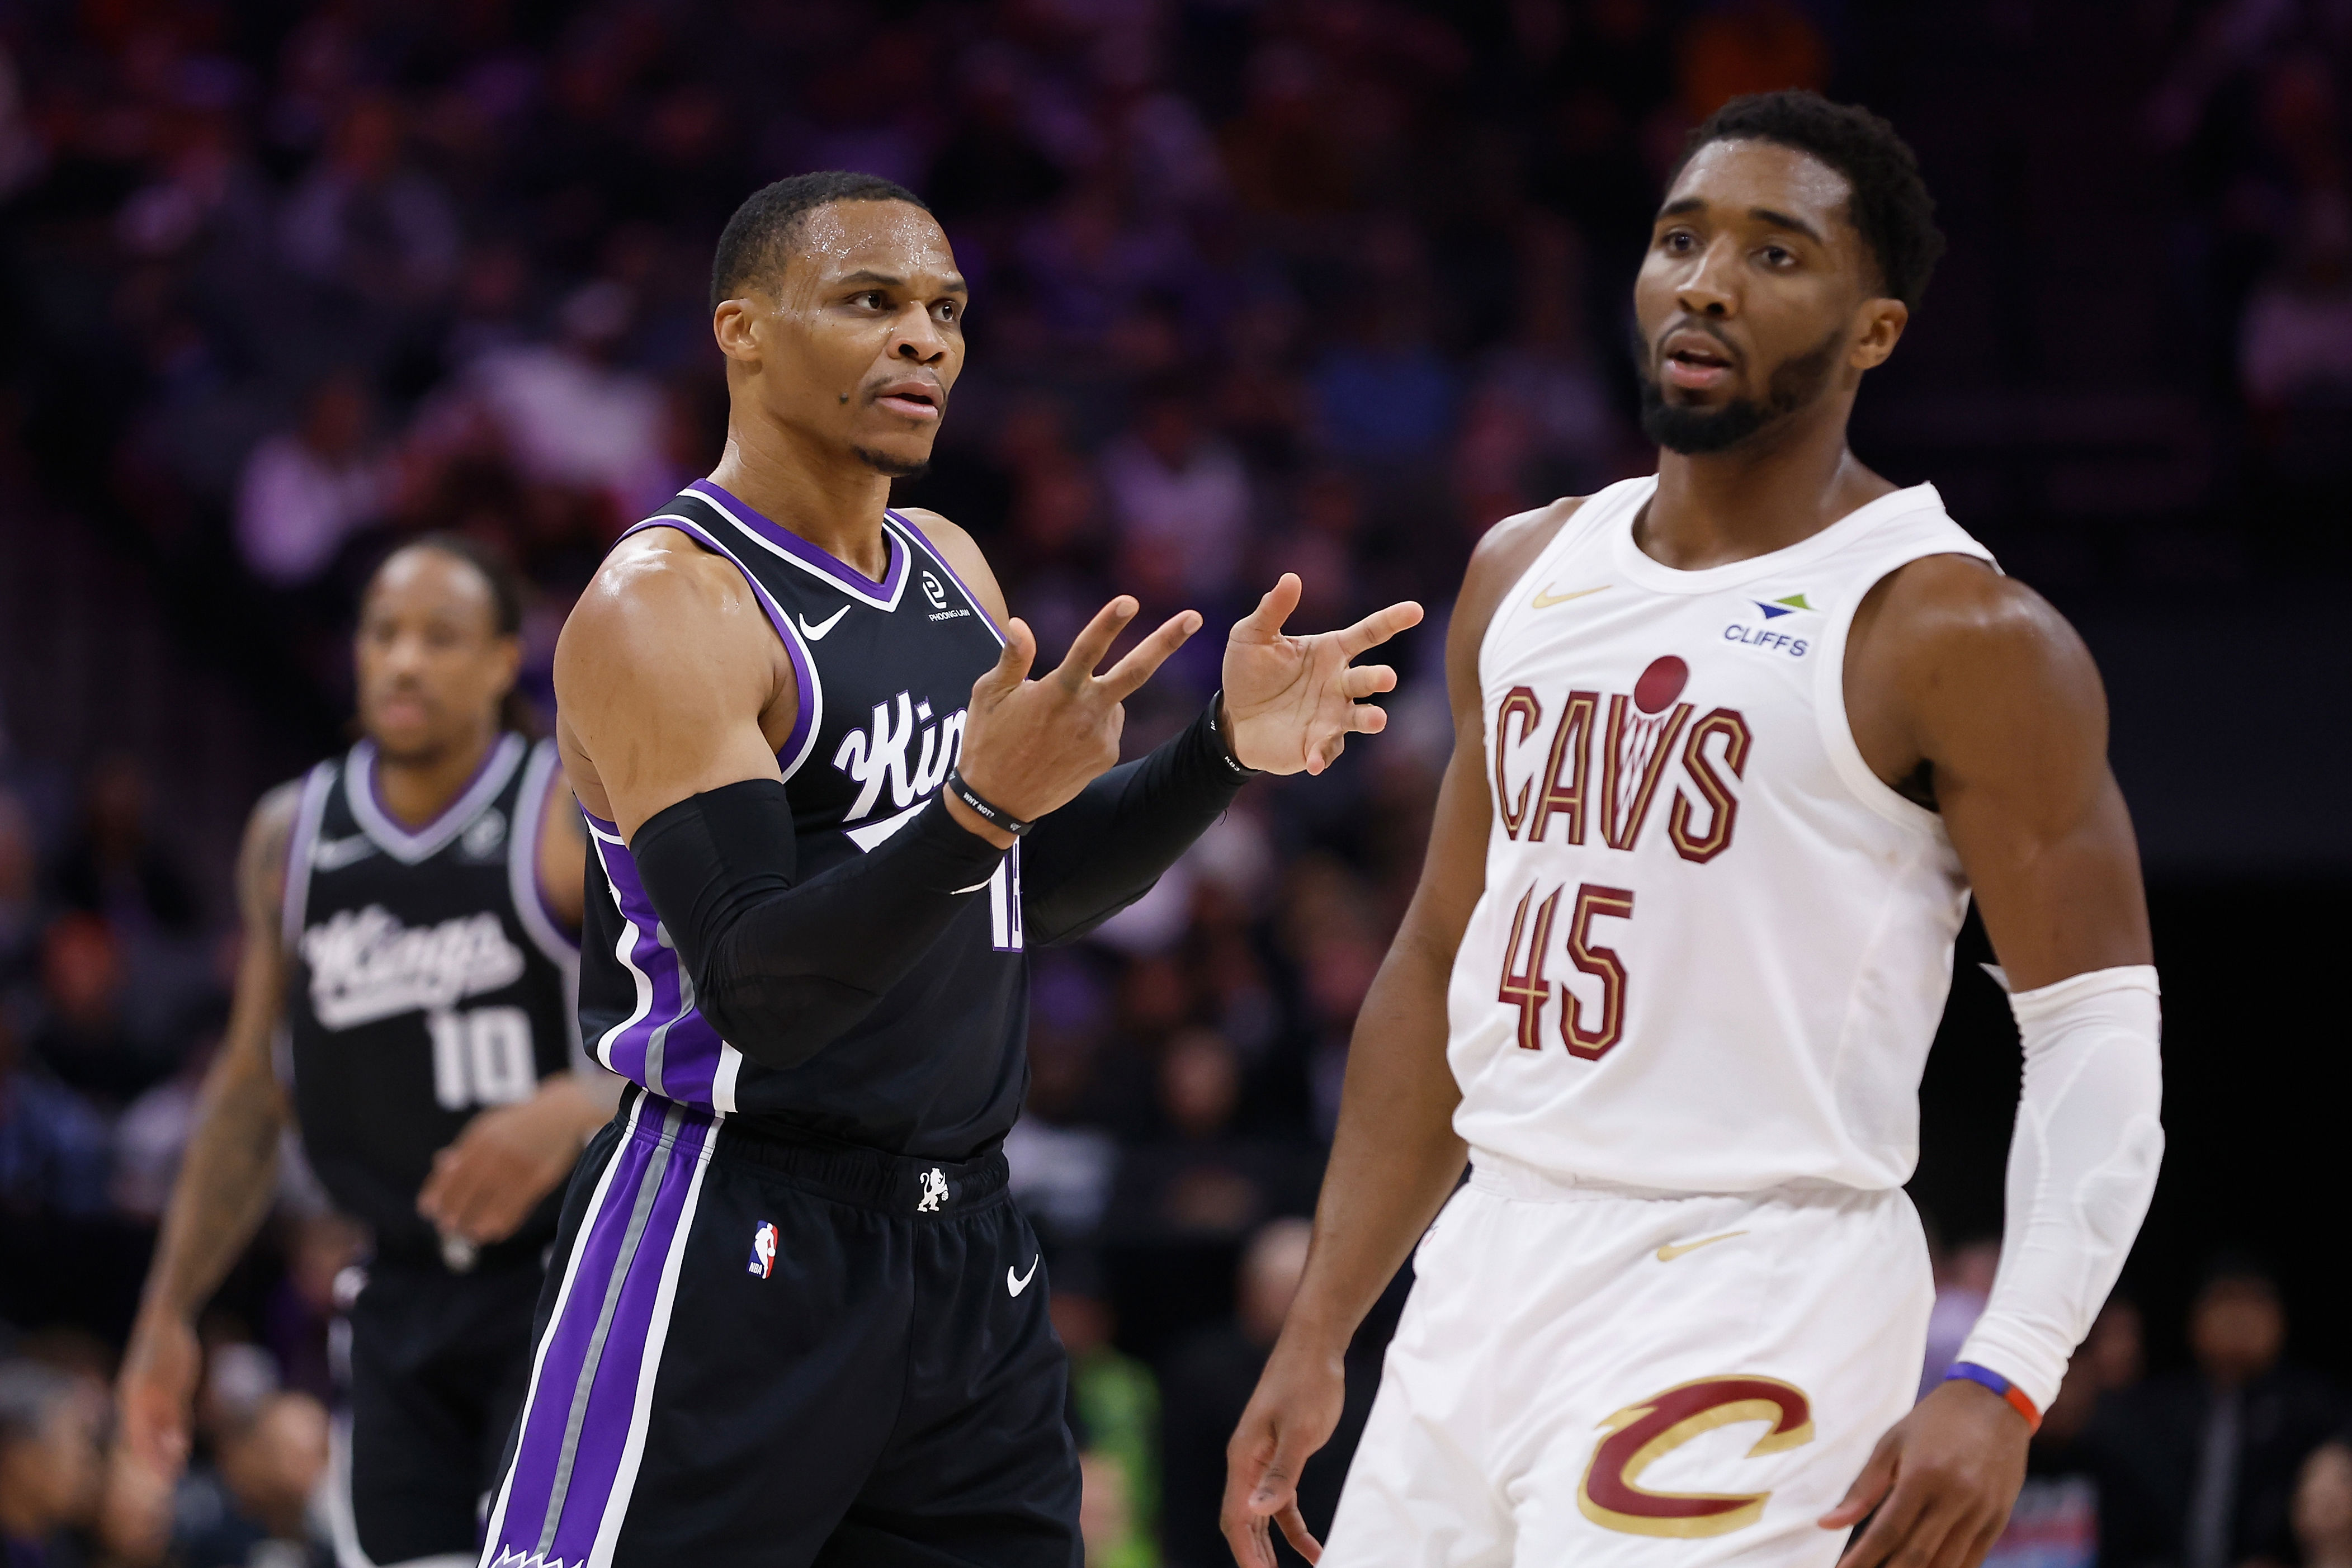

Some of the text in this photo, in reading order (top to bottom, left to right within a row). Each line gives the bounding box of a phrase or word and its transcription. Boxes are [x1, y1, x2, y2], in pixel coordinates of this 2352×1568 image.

[1725, 624, 1809, 657] CLIFFS
[831, 689, 969, 823] Kin
[963, 792, 995, 819] WHY NOT?
[1496, 685, 1754, 865] CAVS
[1498, 876, 1635, 1062] 45
[427, 1007, 537, 1111] 10
[748, 1262, 763, 1275] NBA
